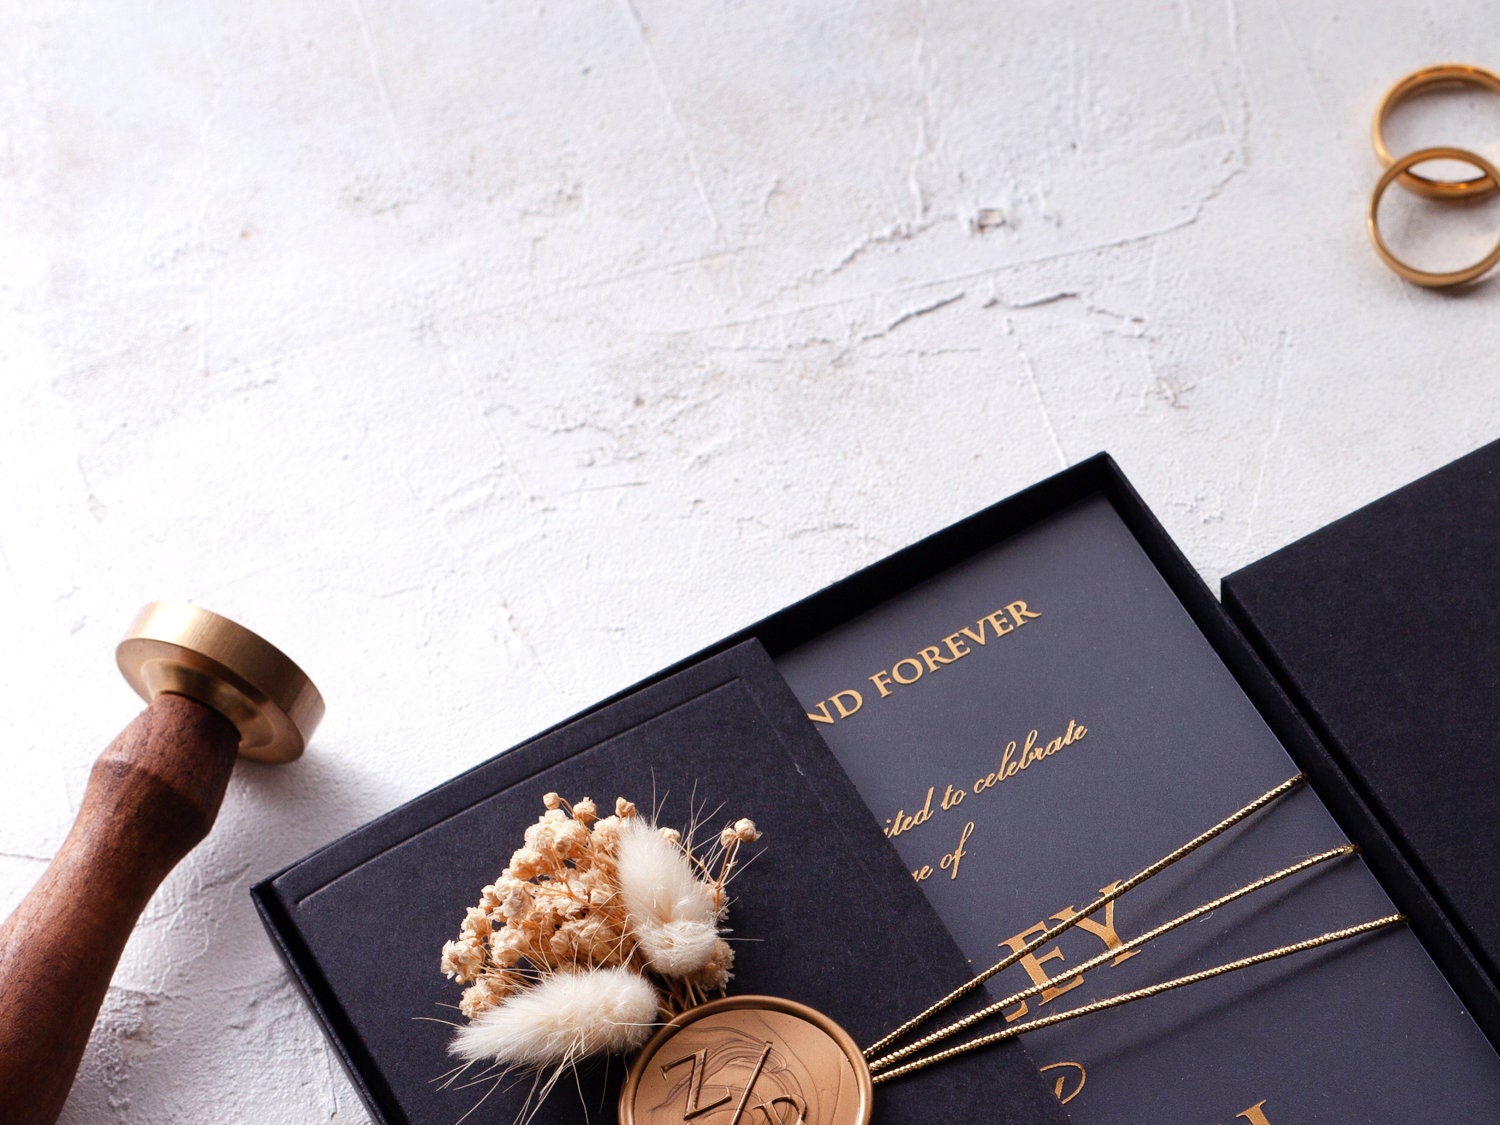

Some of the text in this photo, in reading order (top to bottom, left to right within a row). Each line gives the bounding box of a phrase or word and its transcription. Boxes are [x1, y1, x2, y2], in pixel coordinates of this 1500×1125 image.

[868, 599, 1042, 698] FOREVER
[940, 784, 967, 811] to
[973, 719, 1088, 795] celebrate
[939, 821, 975, 880] of
